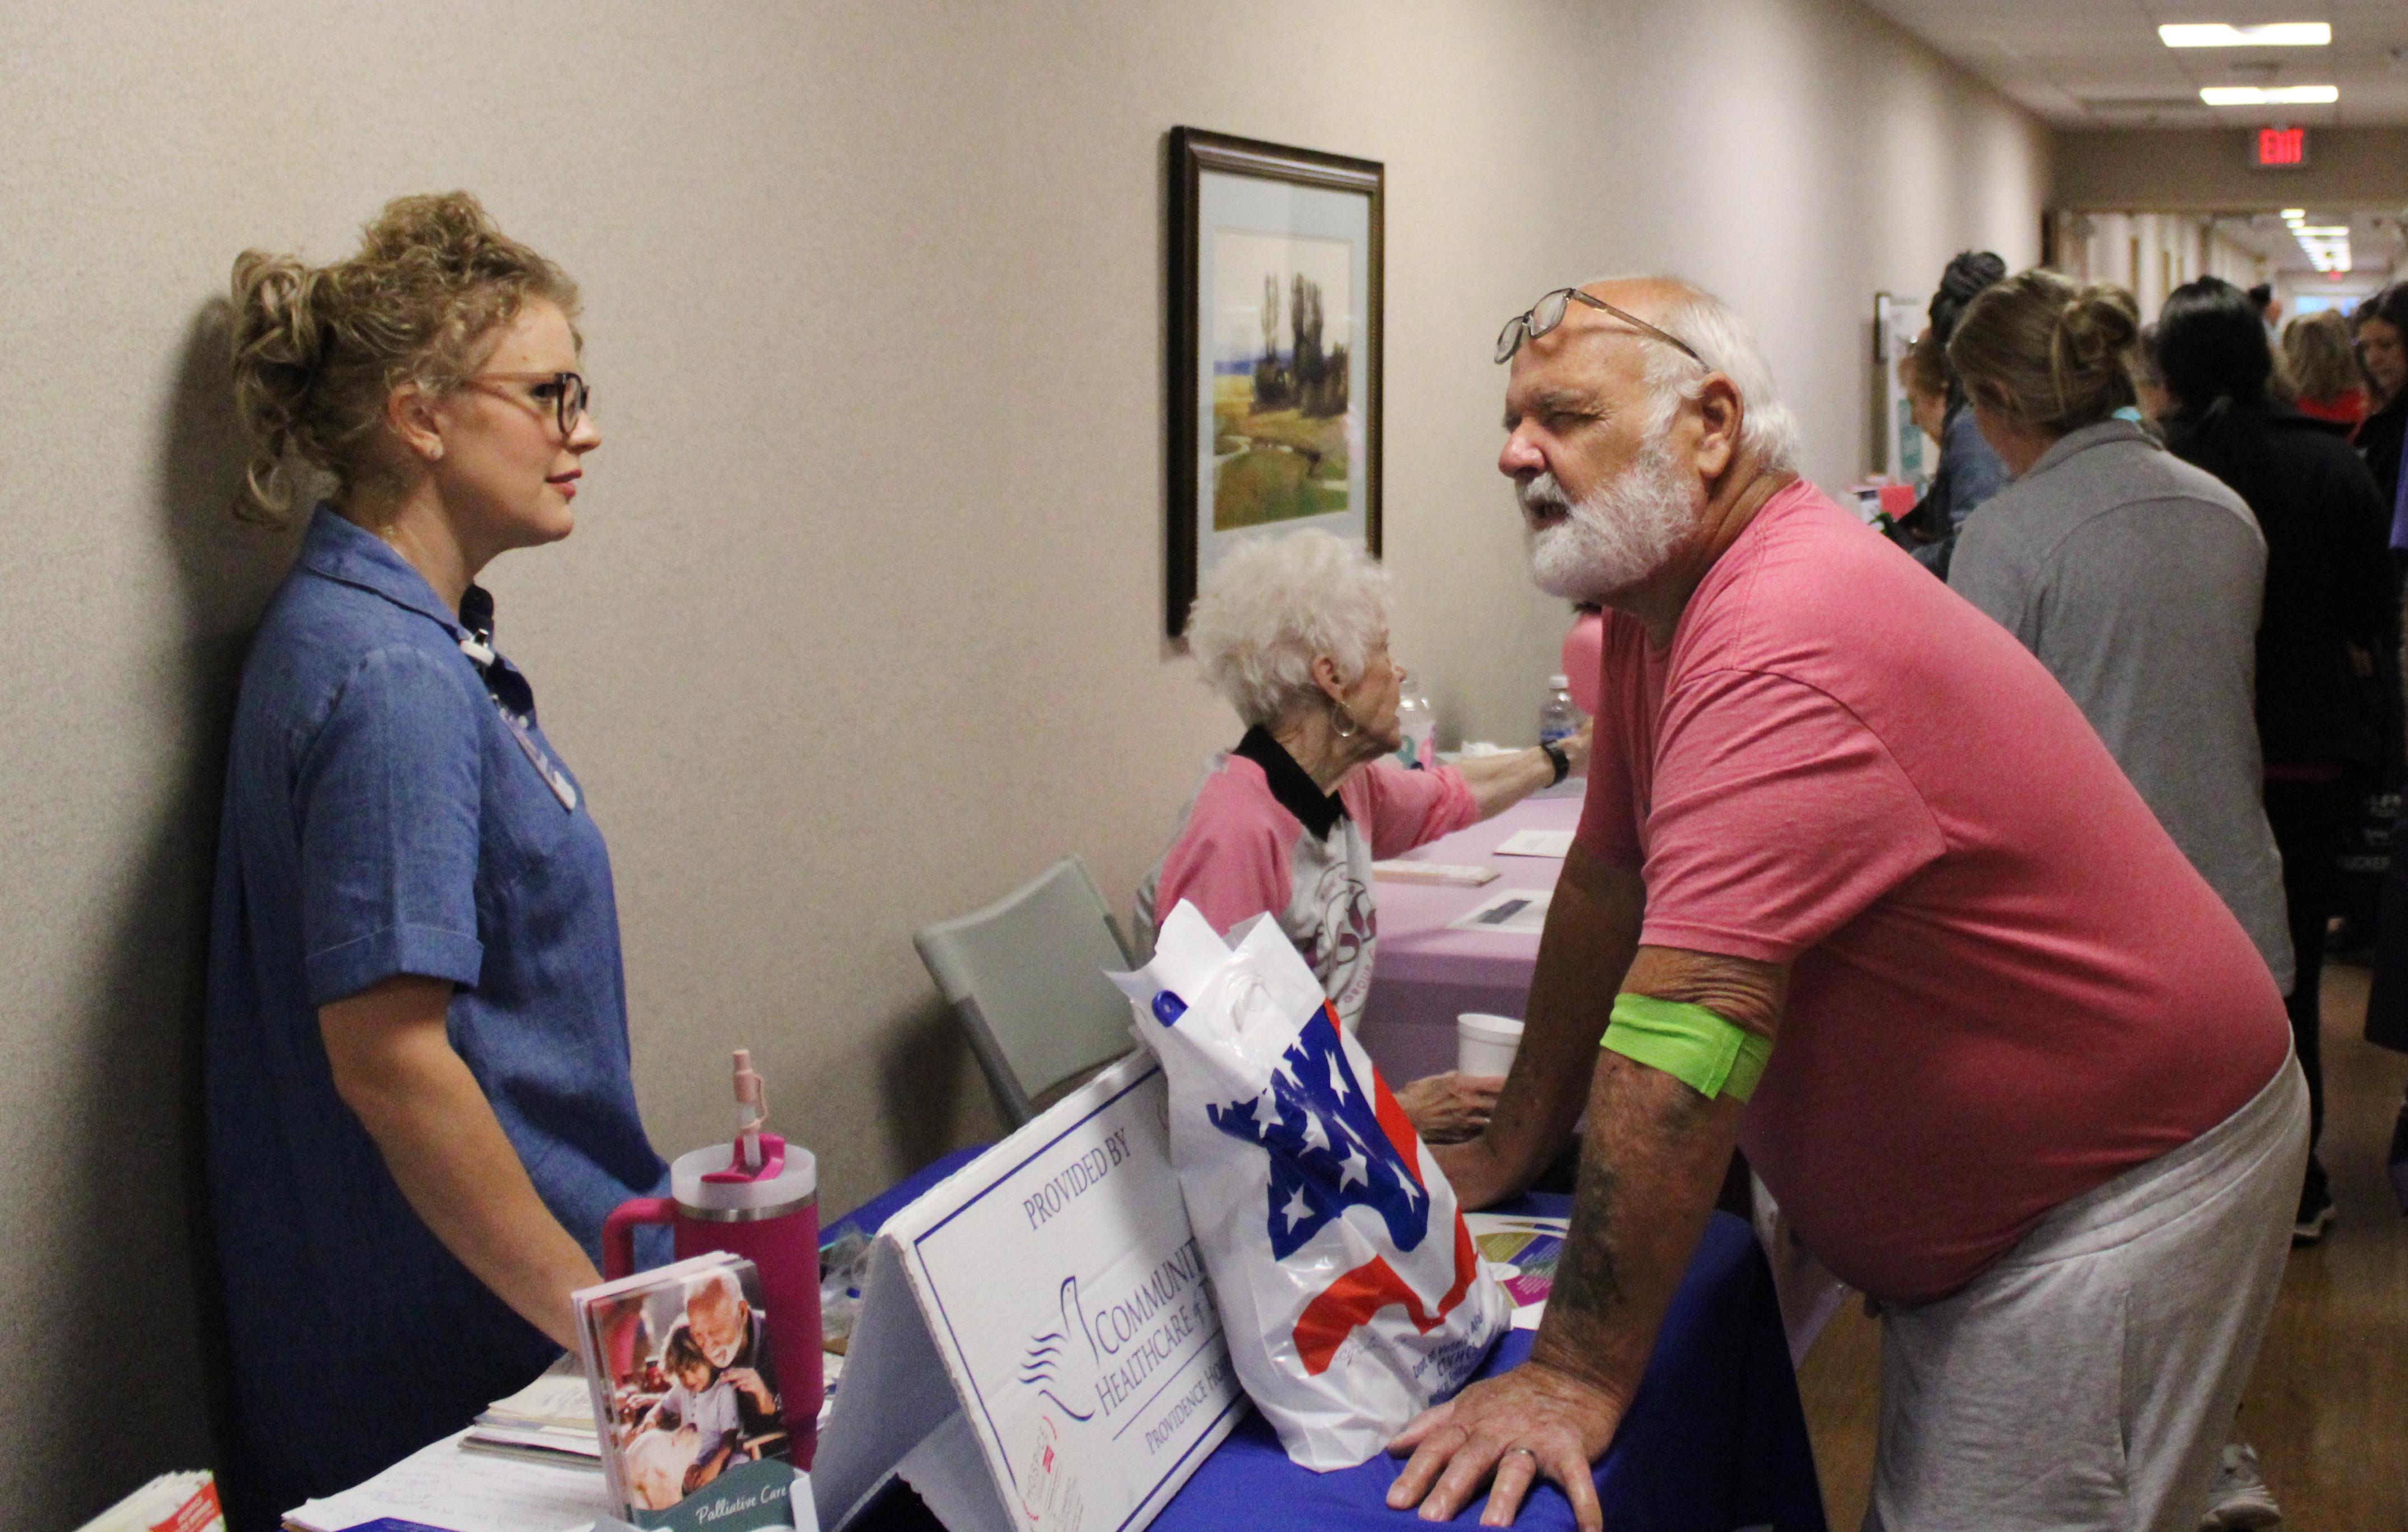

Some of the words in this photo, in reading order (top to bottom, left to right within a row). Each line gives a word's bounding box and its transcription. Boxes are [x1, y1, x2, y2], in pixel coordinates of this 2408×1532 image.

[1023, 1148, 1107, 1230] PROVIDED
[1105, 1128, 1130, 1167] BY
[1096, 1236, 1206, 1354] COMMUNIT
[1095, 1305, 1194, 1417] HEALTHCARE
[1145, 1380, 1207, 1455] PROVIDENCE
[696, 1498, 756, 1524] Palliative
[760, 1485, 786, 1503] Care
